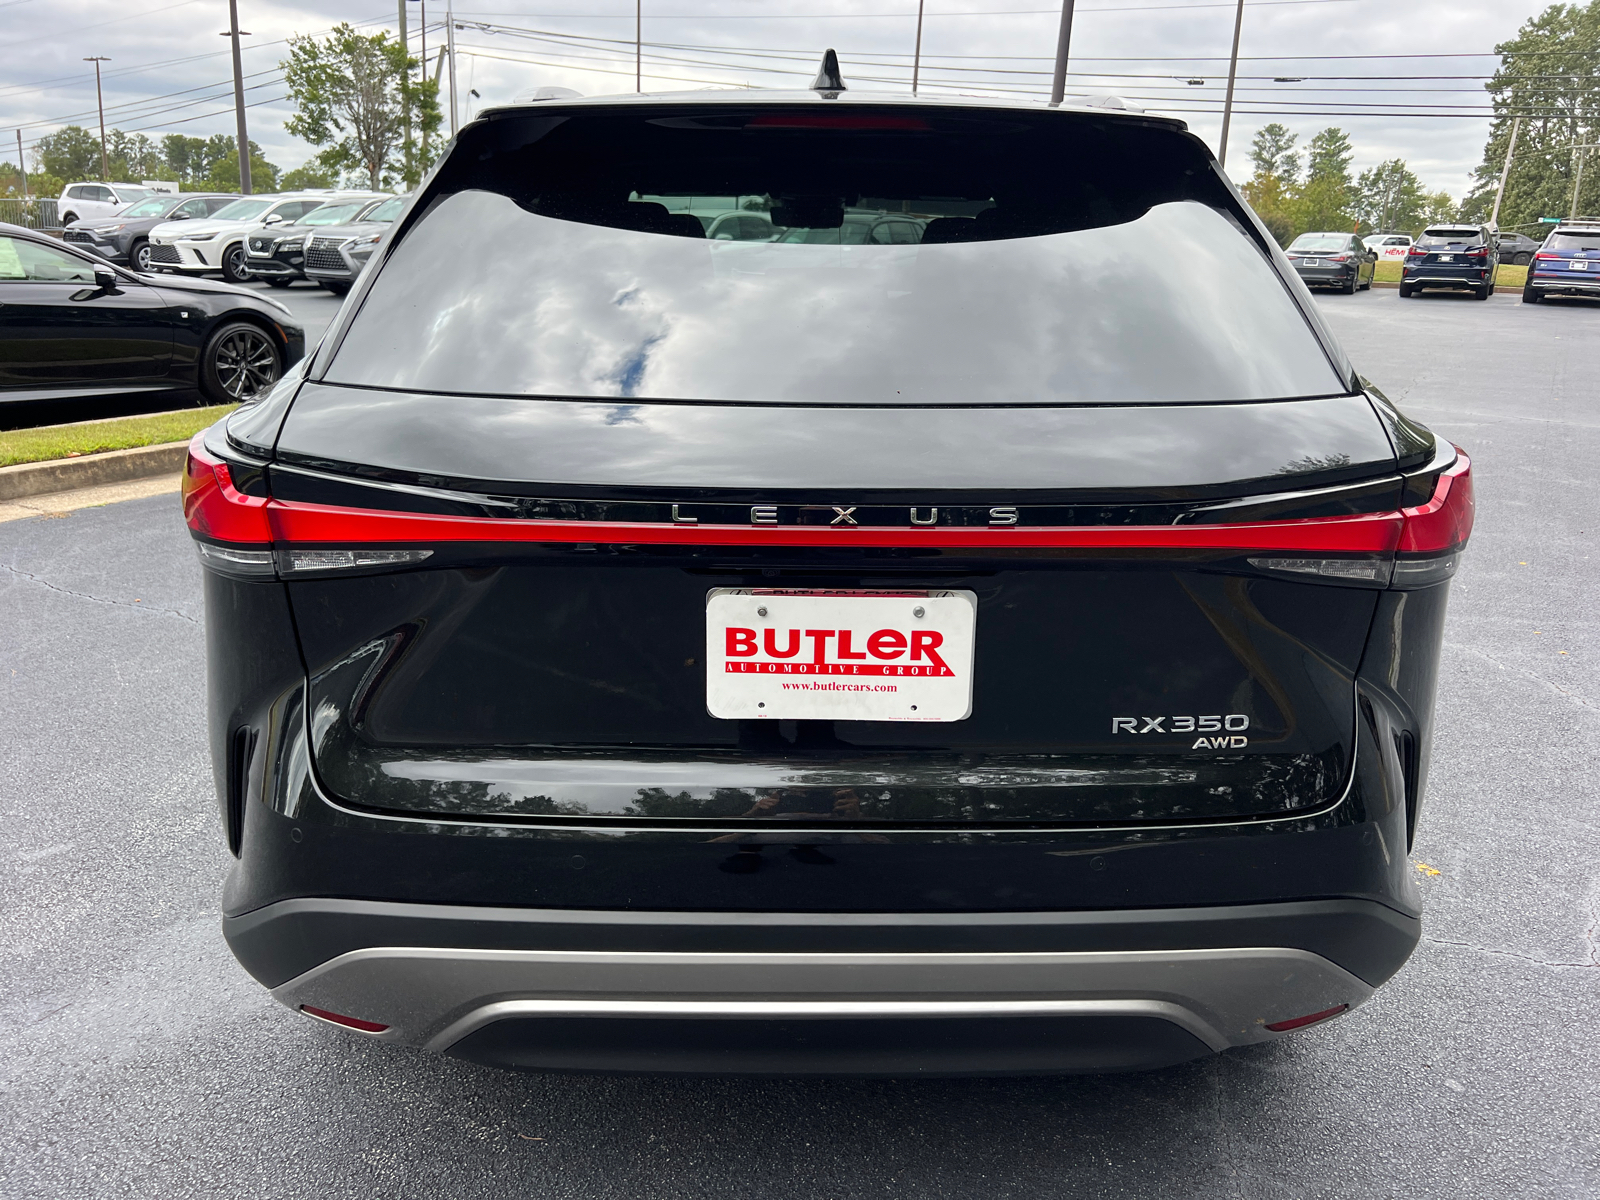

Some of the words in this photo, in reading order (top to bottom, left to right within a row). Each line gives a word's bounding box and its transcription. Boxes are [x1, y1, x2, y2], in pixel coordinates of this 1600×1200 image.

[671, 504, 1018, 525] LEXUS
[726, 662, 860, 675] AUTOMOTIVE
[882, 665, 948, 676] GROUP
[781, 681, 898, 693] www.butlercars.com
[1191, 736, 1248, 750] AWD
